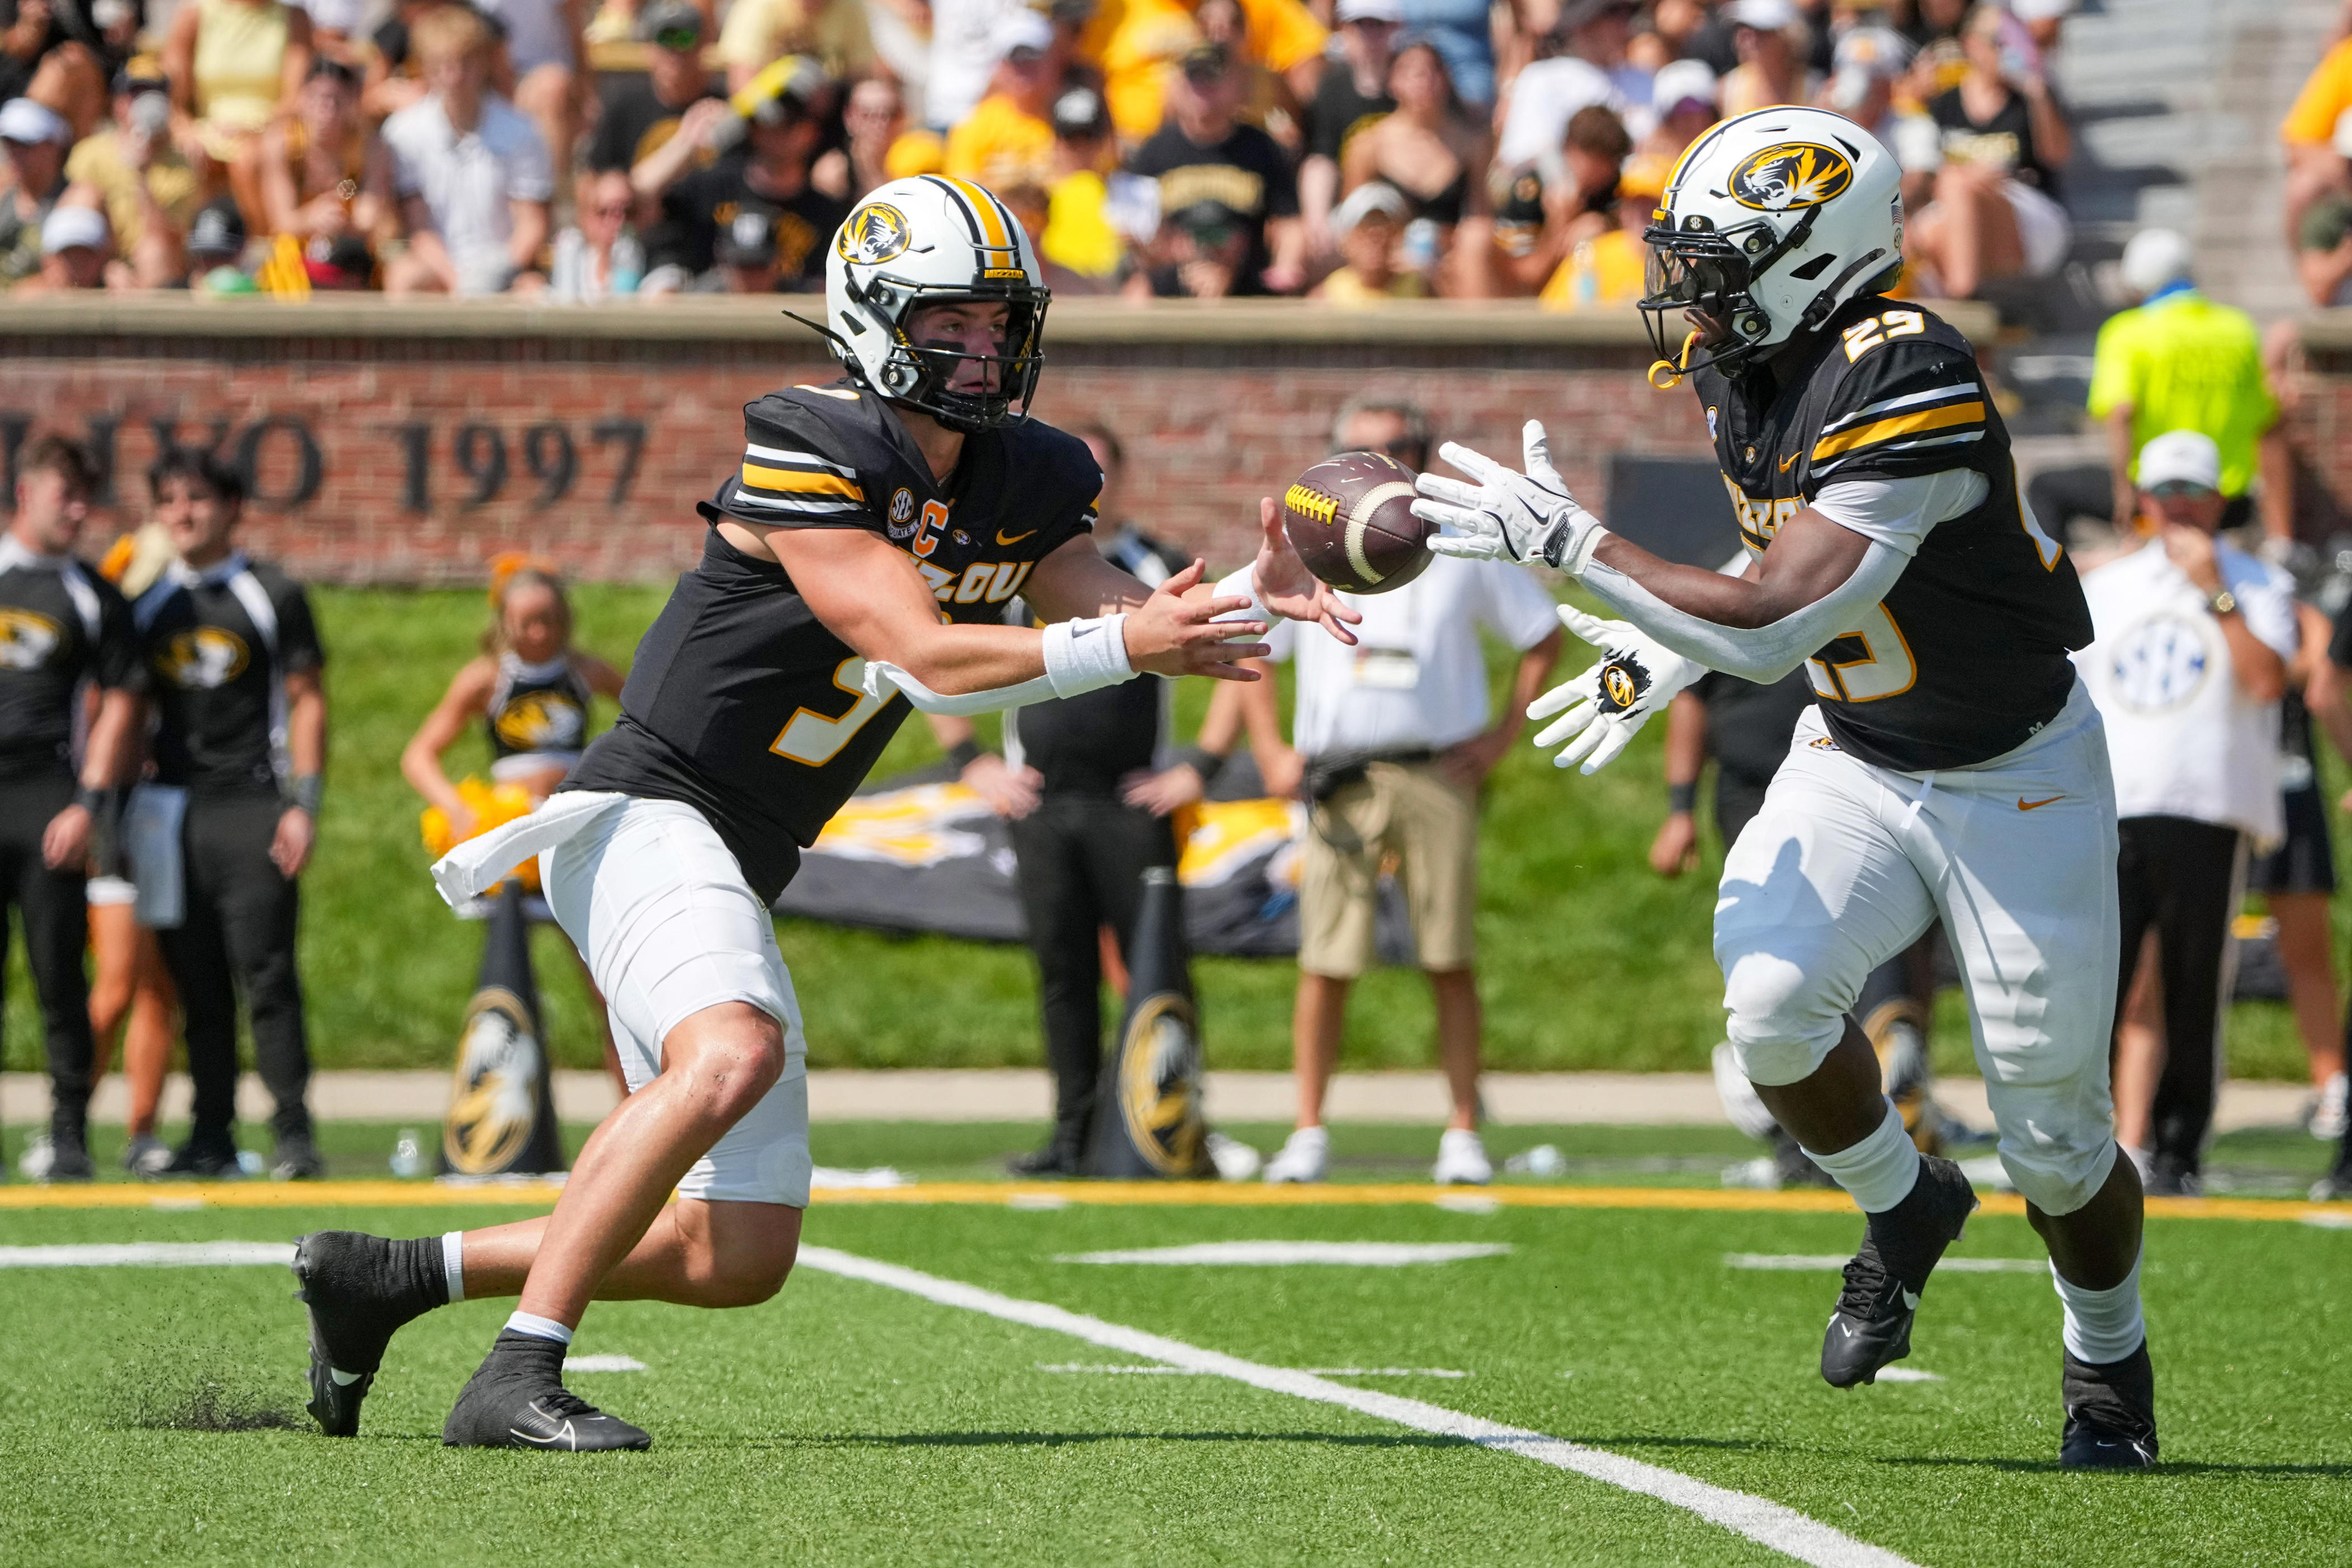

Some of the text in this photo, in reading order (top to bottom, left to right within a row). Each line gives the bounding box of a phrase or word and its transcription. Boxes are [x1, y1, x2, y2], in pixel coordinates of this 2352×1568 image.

[1843, 310, 1925, 363] 29
[376, 419, 649, 512] 1997
[892, 490, 912, 520] SEC
[913, 498, 949, 559] C
